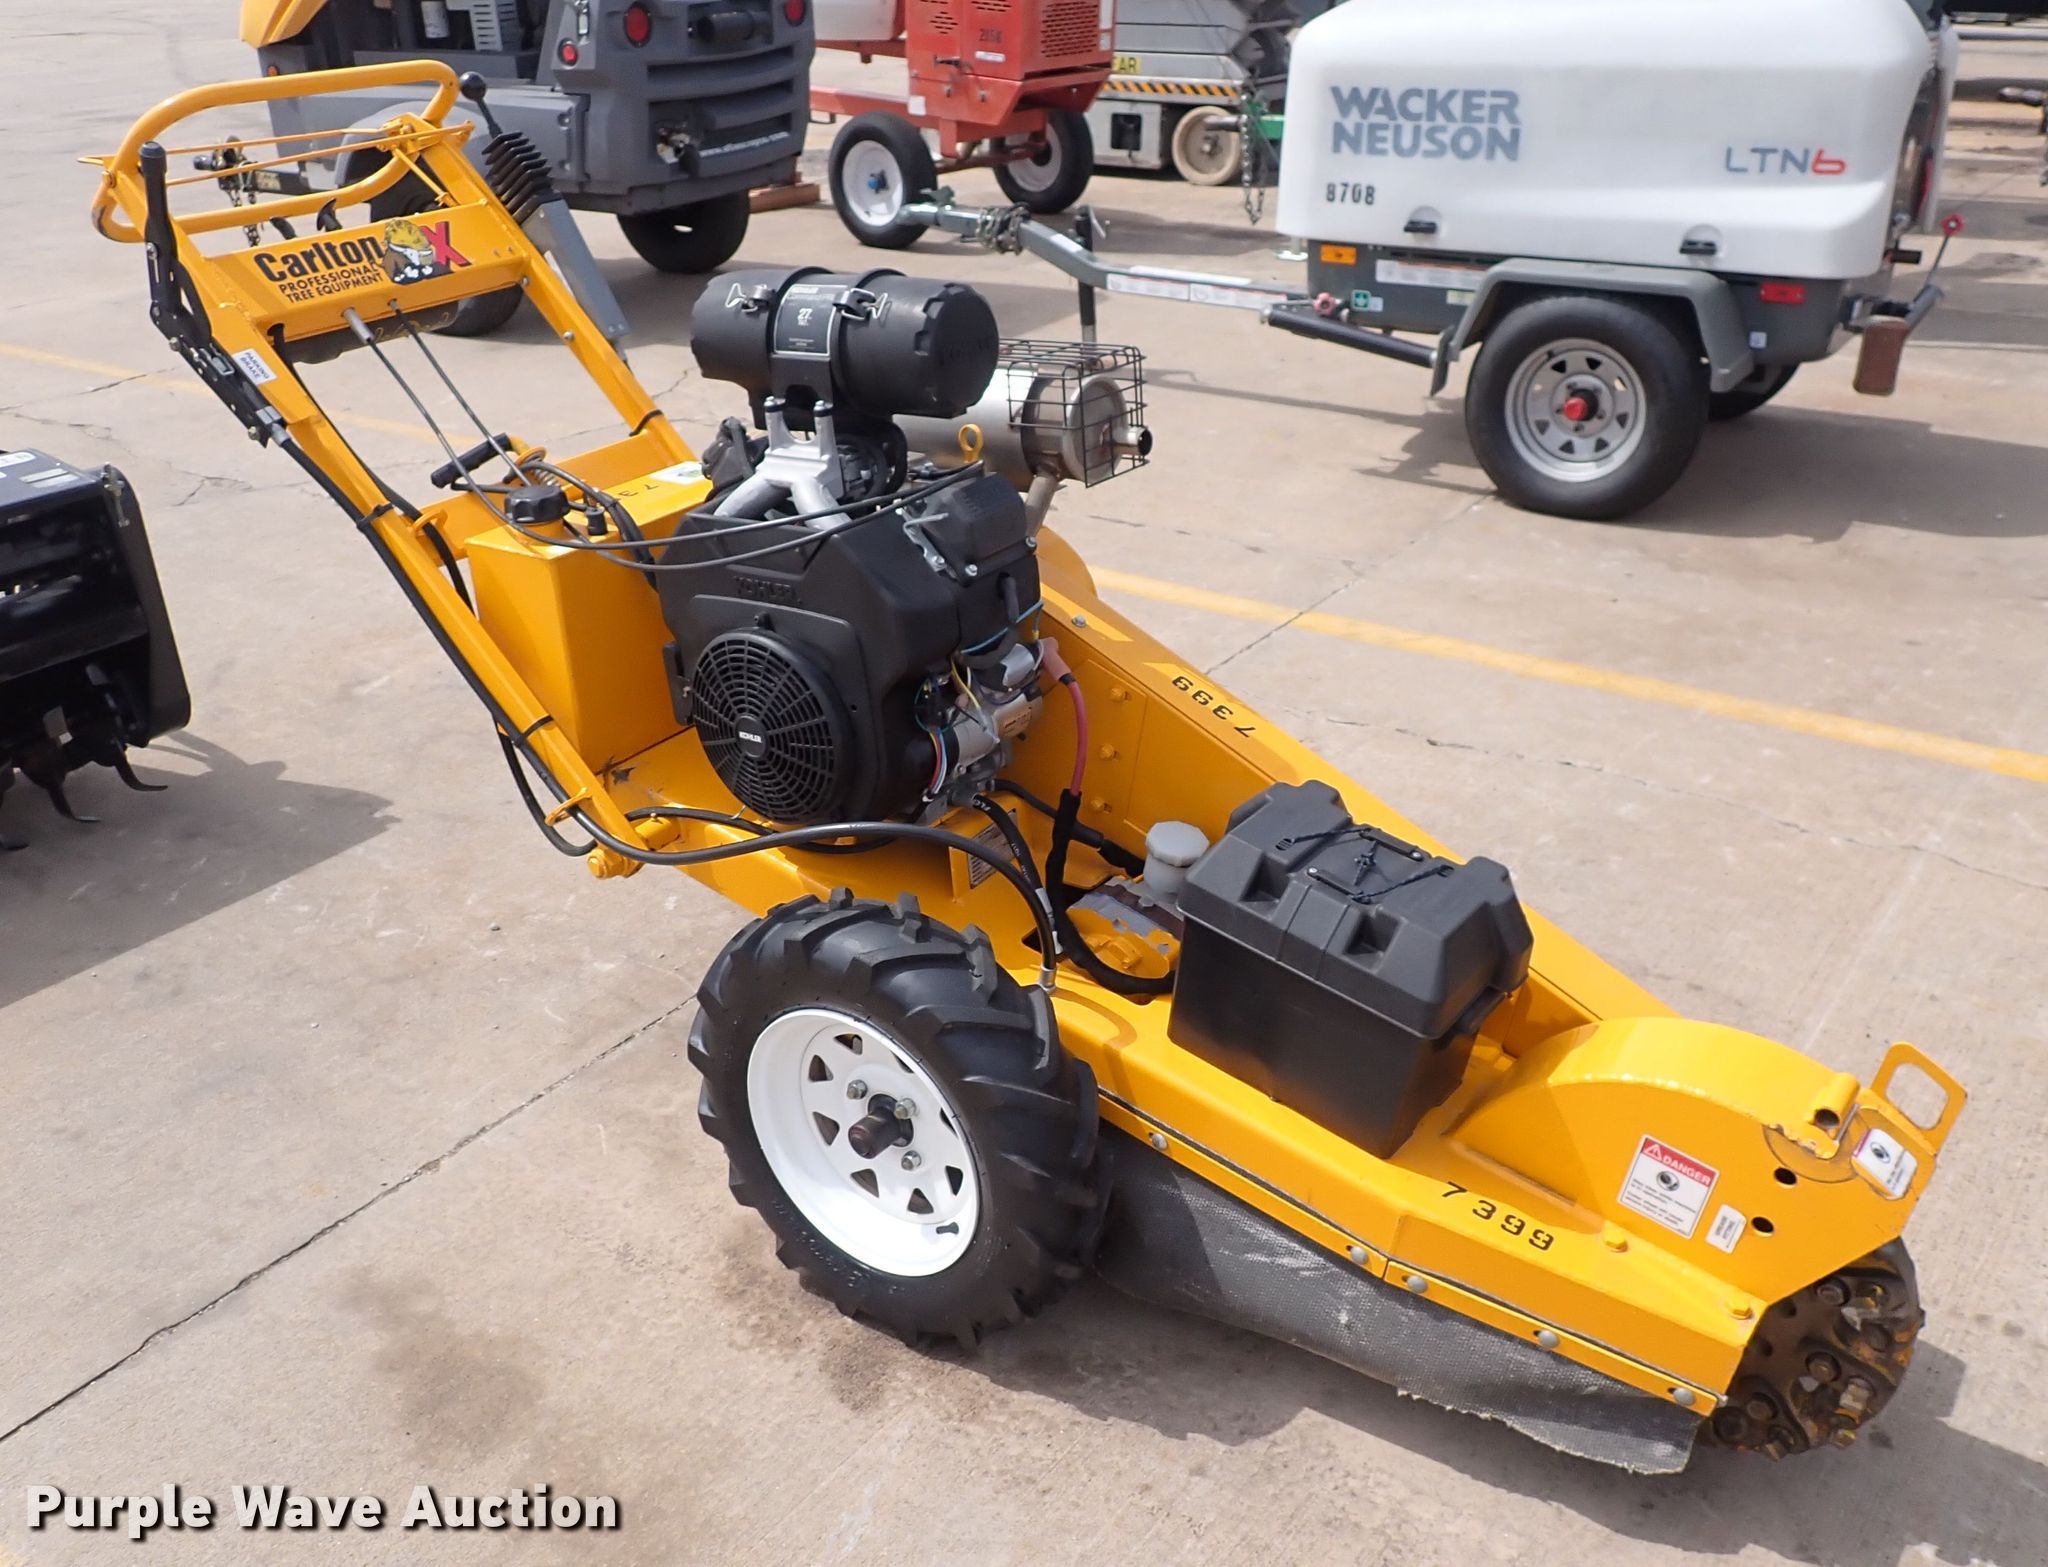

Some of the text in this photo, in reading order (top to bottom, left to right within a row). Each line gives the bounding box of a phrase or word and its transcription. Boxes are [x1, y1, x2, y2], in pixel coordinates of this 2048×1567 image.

[1330, 86, 1521, 125] WACKER
[1332, 122, 1521, 161] NEUSON
[1725, 147, 1846, 175] LTN6
[1326, 183, 1375, 205] 8708
[254, 236, 385, 282] Carlton
[278, 262, 379, 294] PROFESSIONAL
[286, 272, 384, 303] TREE EQUIPMENT
[1172, 676, 1256, 738] 7399
[1662, 1154, 1712, 1185] DANGER
[1442, 1181, 1554, 1251] 7399
